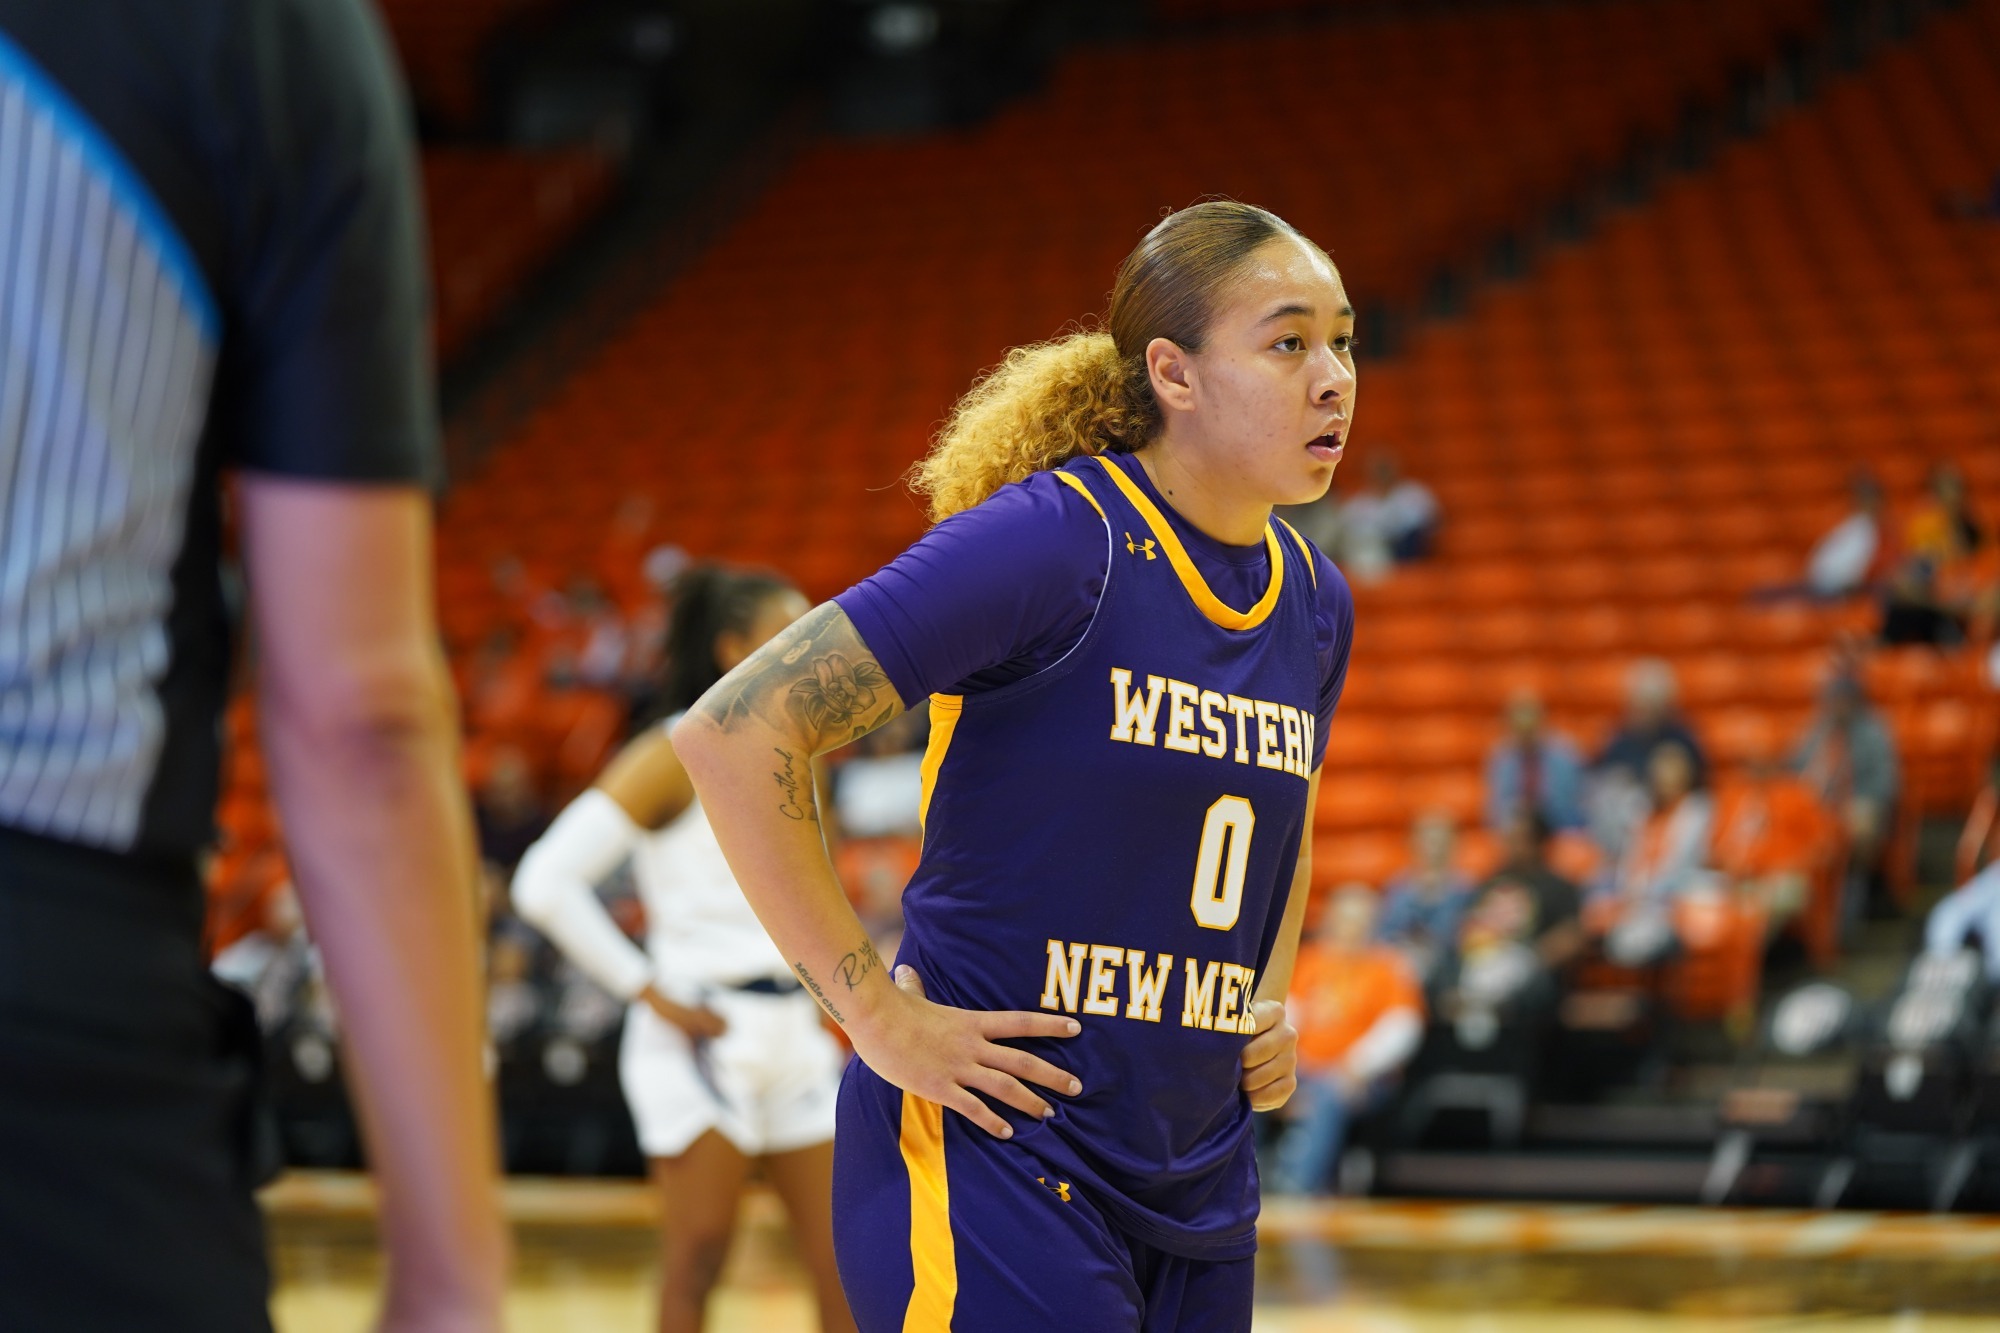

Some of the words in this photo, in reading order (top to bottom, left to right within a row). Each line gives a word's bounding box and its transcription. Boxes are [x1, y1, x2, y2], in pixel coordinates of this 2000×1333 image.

[1110, 667, 1315, 781] WESTERN
[1190, 794, 1256, 931] 0
[794, 961, 824, 998] Middle
[822, 998, 845, 1024] child
[1040, 939, 1173, 1023] NEW
[1181, 958, 1256, 1035] MEX
